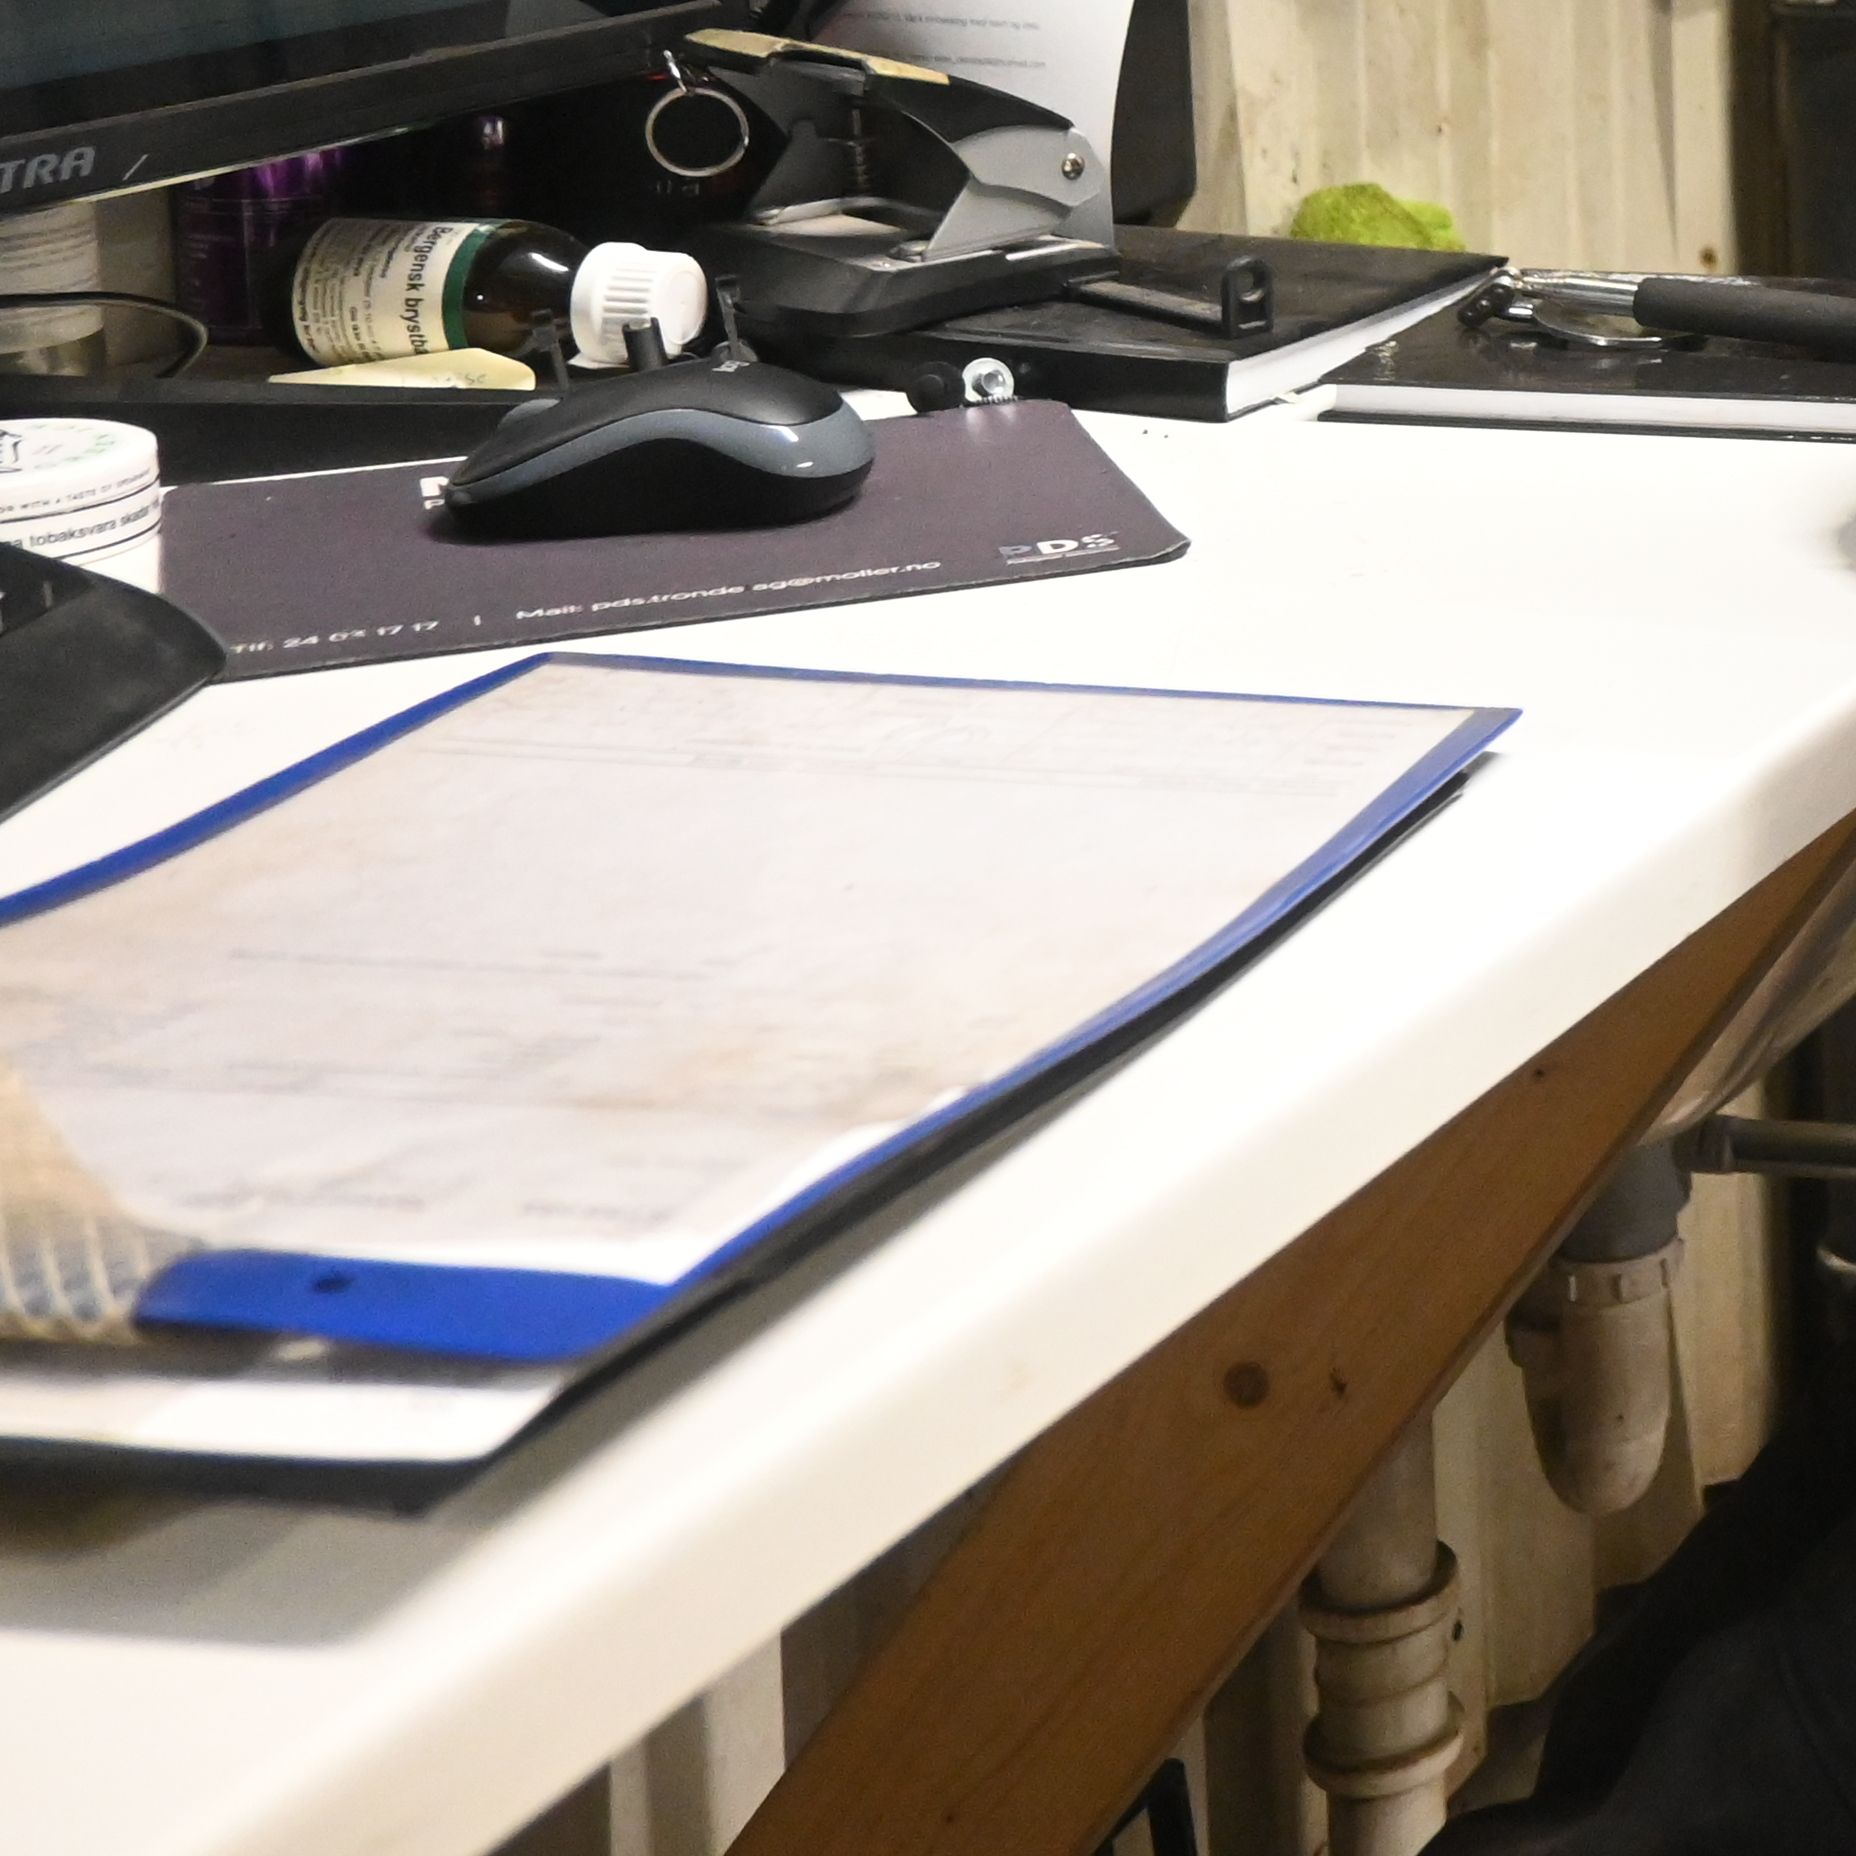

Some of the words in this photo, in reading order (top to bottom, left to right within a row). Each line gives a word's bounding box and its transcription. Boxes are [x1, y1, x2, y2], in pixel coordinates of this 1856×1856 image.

[403, 225, 454, 292] Bergensk
[29, 519, 118, 547] tobaksvara
[998, 532, 1116, 559] PDS
[282, 635, 320, 649] 24
[376, 624, 404, 637] 17
[411, 620, 439, 632] 17
[515, 603, 584, 620] Mail:
